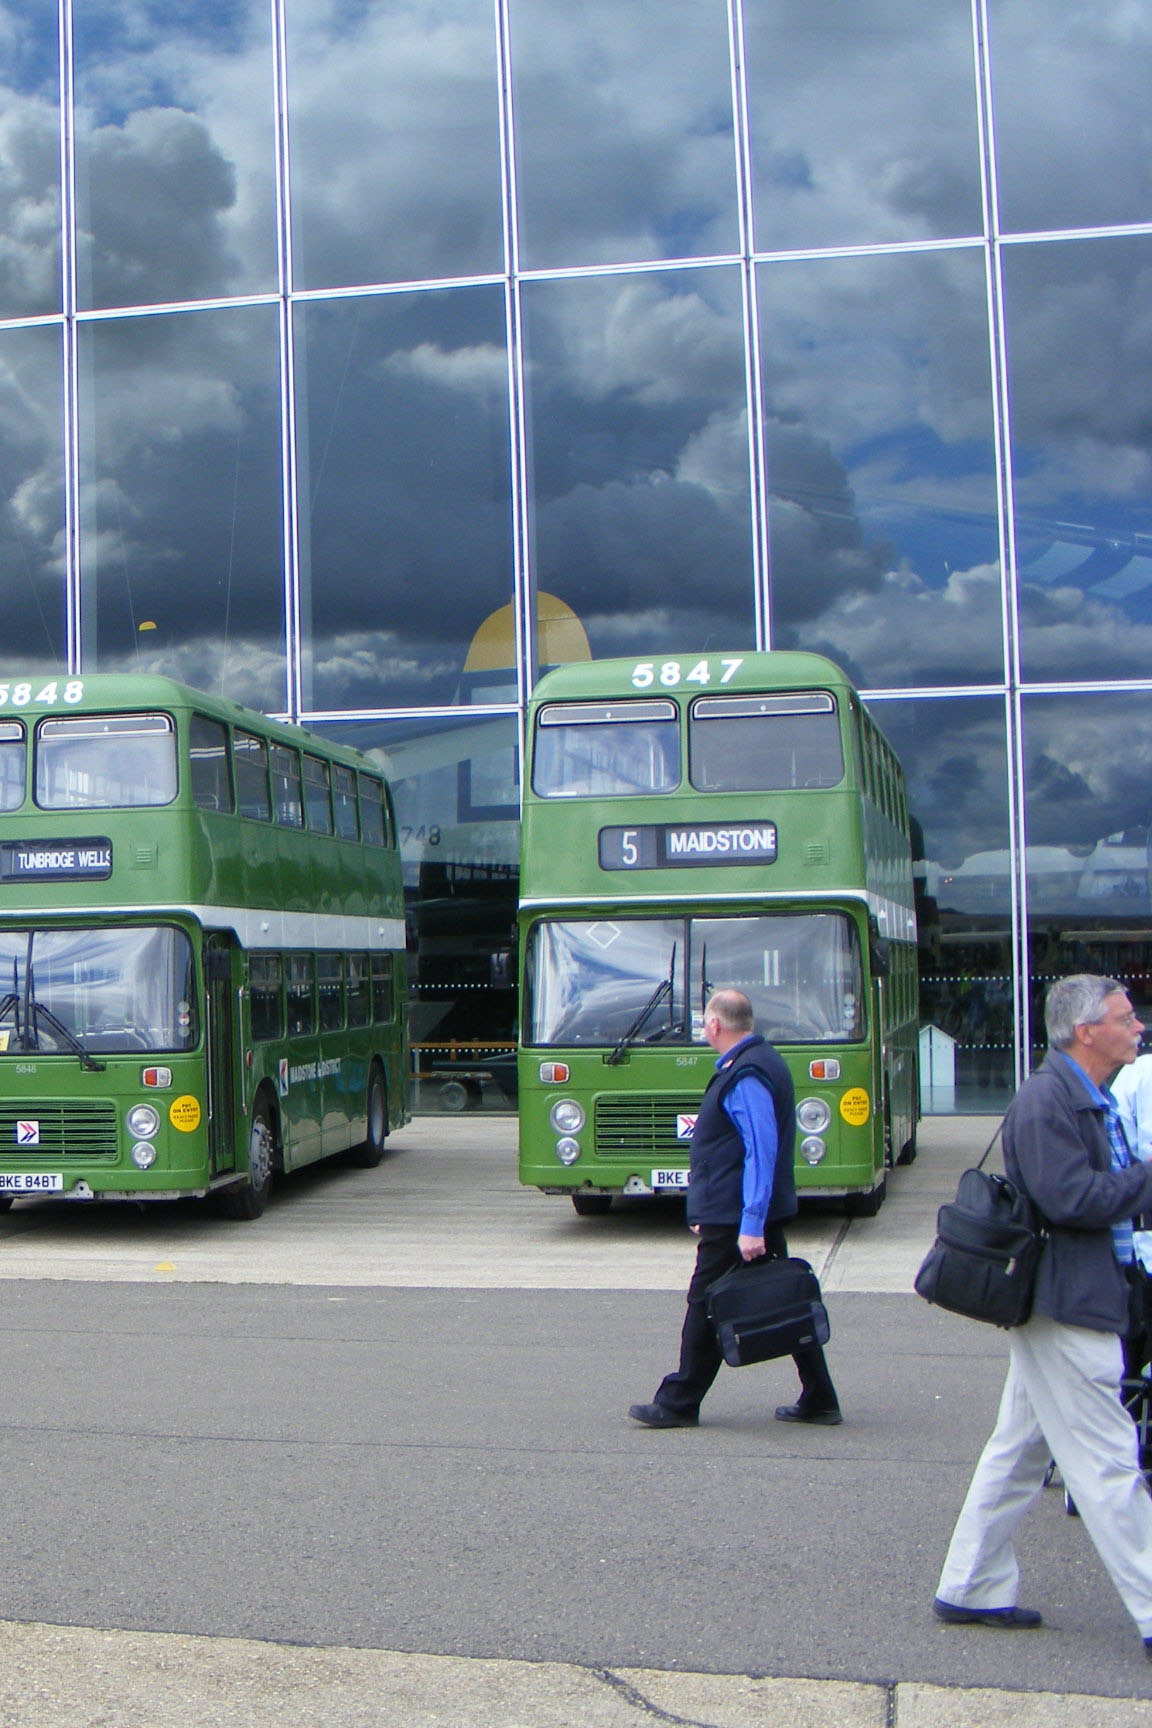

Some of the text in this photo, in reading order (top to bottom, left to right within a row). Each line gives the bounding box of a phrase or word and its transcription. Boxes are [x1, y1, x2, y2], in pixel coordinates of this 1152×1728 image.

[631, 659, 744, 688] 5847
[622, 831, 638, 865] 5
[670, 829, 776, 853] MAIDSTONE
[18, 850, 111, 869] TUNBRIDGE WELLS
[16, 1064, 37, 1074] 5848
[676, 1056, 698, 1066] 5847
[25, 1175, 57, 1188] 848T
[657, 1171, 684, 1184] BKE
